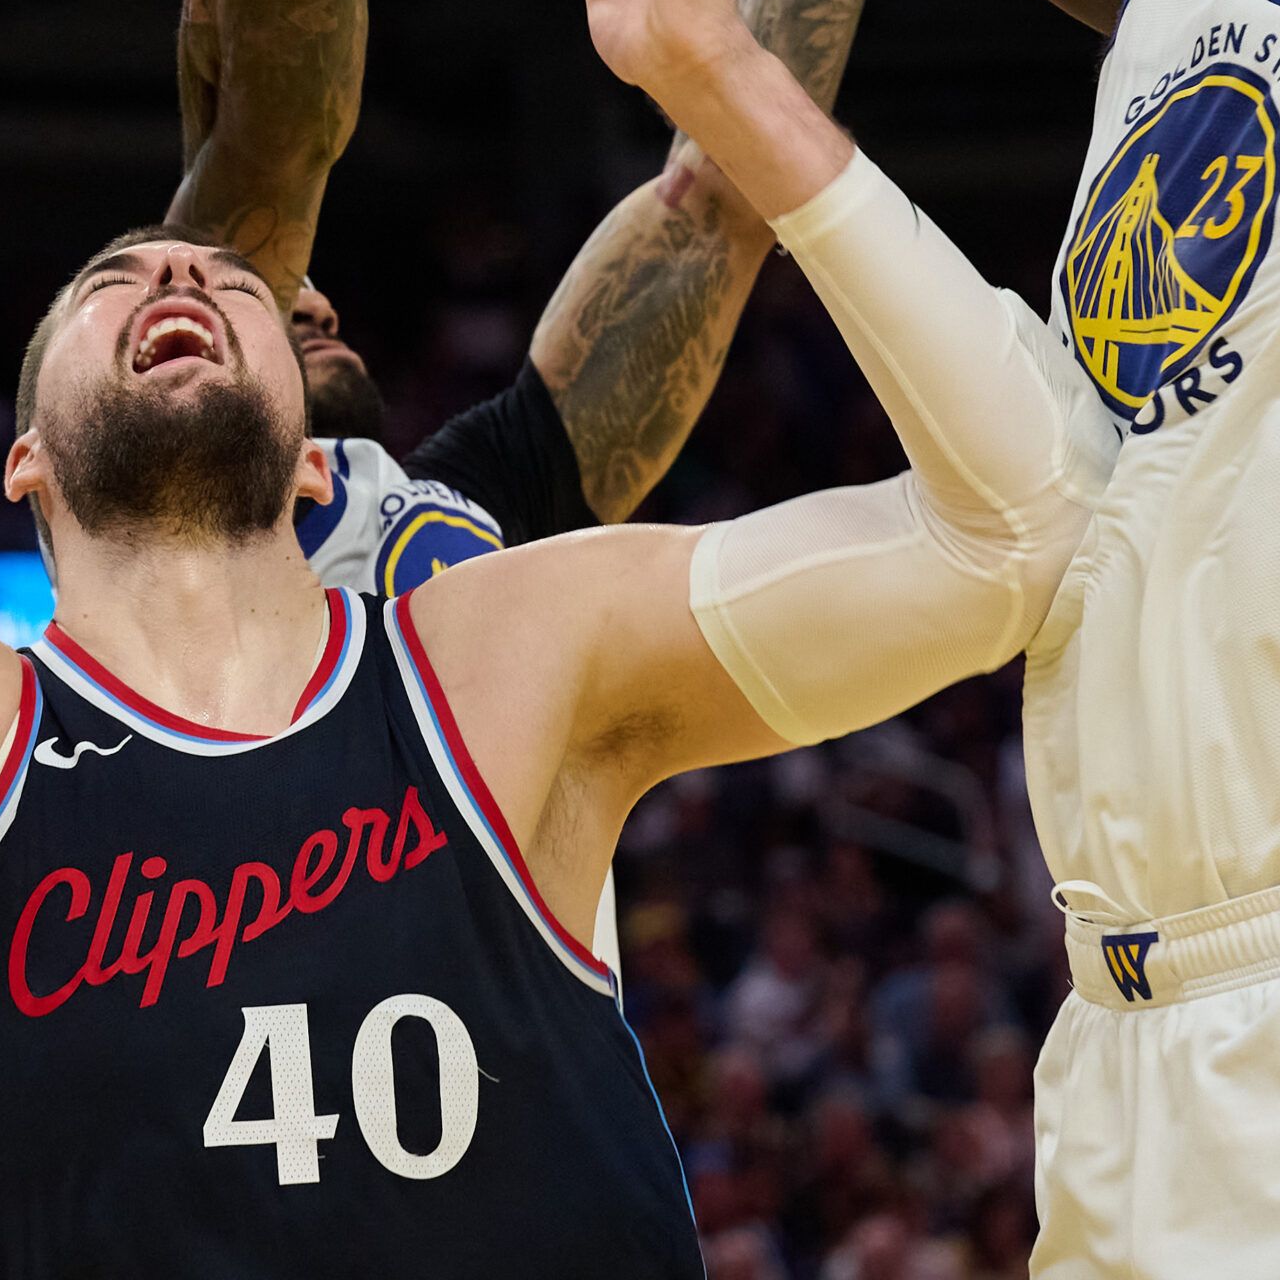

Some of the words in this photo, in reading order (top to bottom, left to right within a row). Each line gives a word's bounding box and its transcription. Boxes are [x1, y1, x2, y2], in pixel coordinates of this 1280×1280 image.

[1124, 22, 1247, 125] GOLDEN
[1174, 154, 1266, 240] 23
[8, 785, 448, 1018] Clippers
[203, 993, 479, 1186] 40
